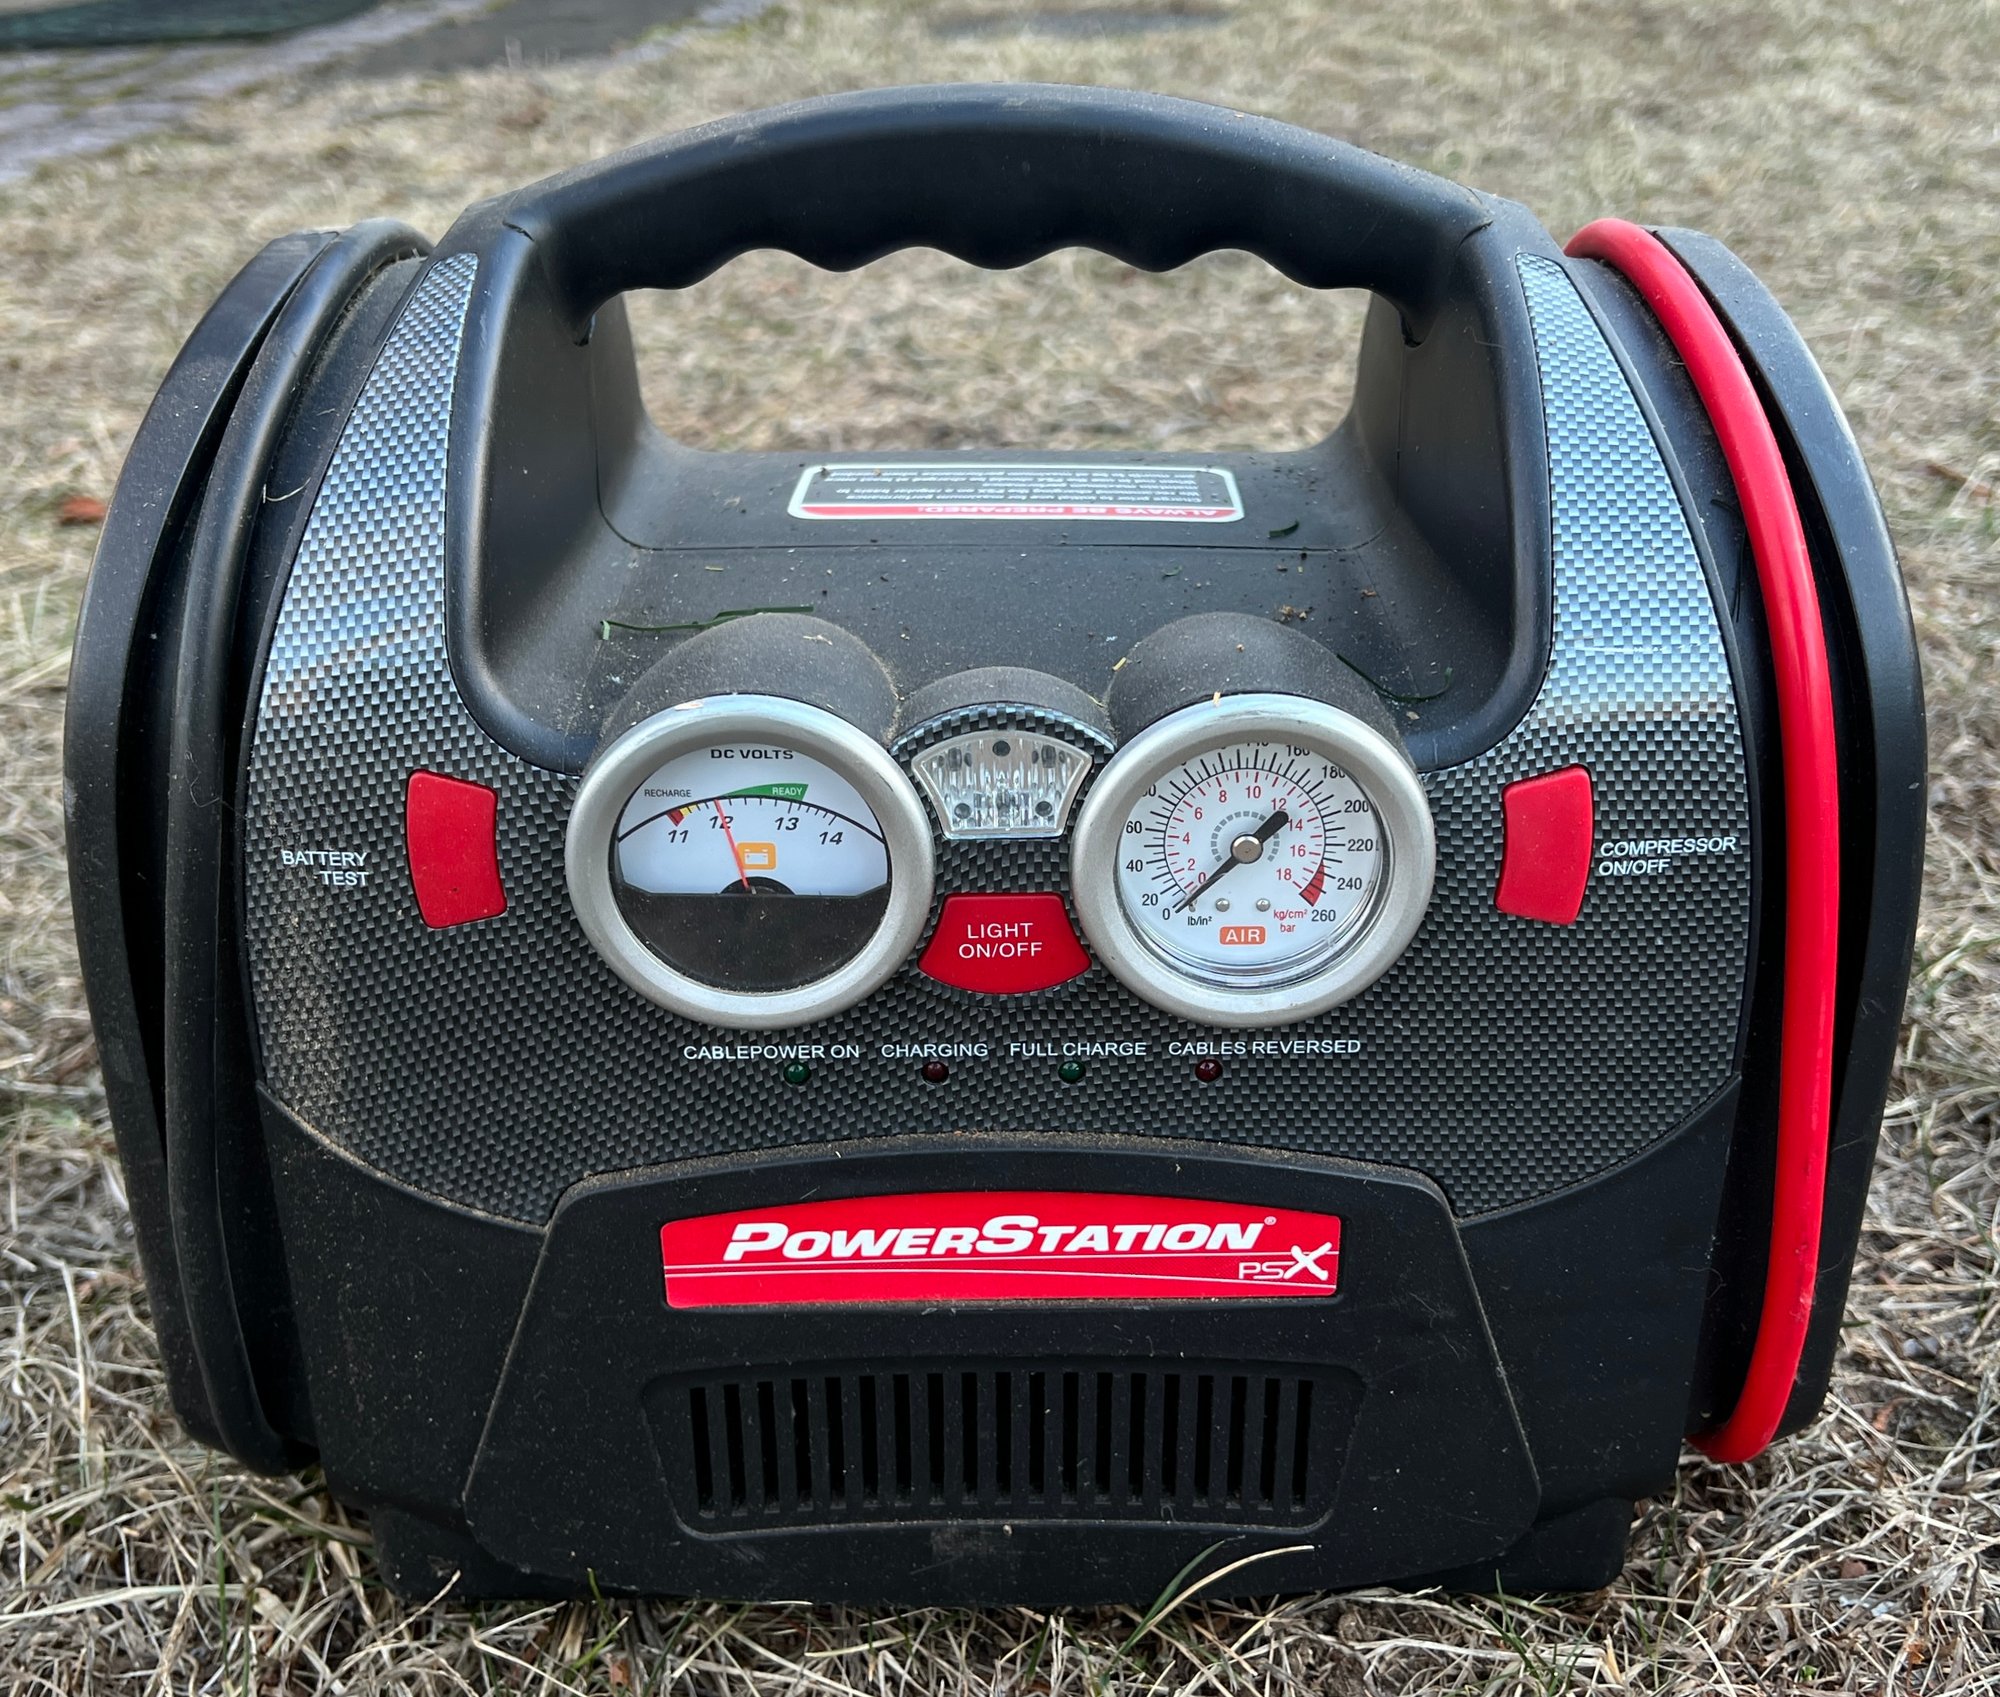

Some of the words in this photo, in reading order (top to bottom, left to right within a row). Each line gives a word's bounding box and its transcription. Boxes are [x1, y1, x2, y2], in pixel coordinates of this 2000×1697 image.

[1115, 508, 1217, 516] ALWAYS
[710, 749, 734, 760] DC
[742, 749, 794, 760] VOLTS
[1286, 745, 1310, 757] 160
[1322, 766, 1345, 779] 180
[644, 788, 692, 797] RECHARGE
[772, 787, 802, 796] READY
[1218, 790, 1227, 802] 8
[1245, 786, 1261, 799] 10
[1271, 798, 1287, 811] 12
[1344, 799, 1369, 813] 200
[1194, 807, 1203, 820] 6
[709, 815, 733, 829] 12
[775, 817, 799, 831] 13
[1126, 821, 1143, 834] 60
[1288, 818, 1303, 831] 14
[667, 829, 689, 843] 11
[819, 831, 843, 845] 14
[1182, 832, 1190, 844] 4
[1290, 845, 1306, 857] 16
[1348, 838, 1373, 852] 220
[1601, 836, 1736, 856] COMPRESSOR
[282, 851, 367, 866] BATTERY
[1187, 859, 1195, 871] 2
[1126, 859, 1143, 872] 40
[1599, 859, 1670, 876] ON/OFF
[320, 871, 369, 886] TEST
[1198, 873, 1206, 885] 0
[1276, 868, 1292, 881] 18
[1337, 878, 1362, 890] 240
[1142, 894, 1159, 906] 20
[1162, 908, 1171, 921] 0
[1312, 910, 1336, 922] 260
[967, 922, 1033, 939] LIGHT
[1280, 923, 1296, 933] bar
[1225, 929, 1261, 943] AIR
[958, 942, 1042, 959] ON/OFF
[683, 1044, 825, 1059] CABLEPOWER
[830, 1044, 860, 1059] ON
[881, 1043, 988, 1057] CHARGING
[1010, 1042, 1058, 1057] FULL
[1062, 1042, 1147, 1056] CHARGE
[1168, 1041, 1246, 1056] CABLES
[1252, 1040, 1361, 1054] REVERSED
[1239, 1241, 1333, 1281] PSX
